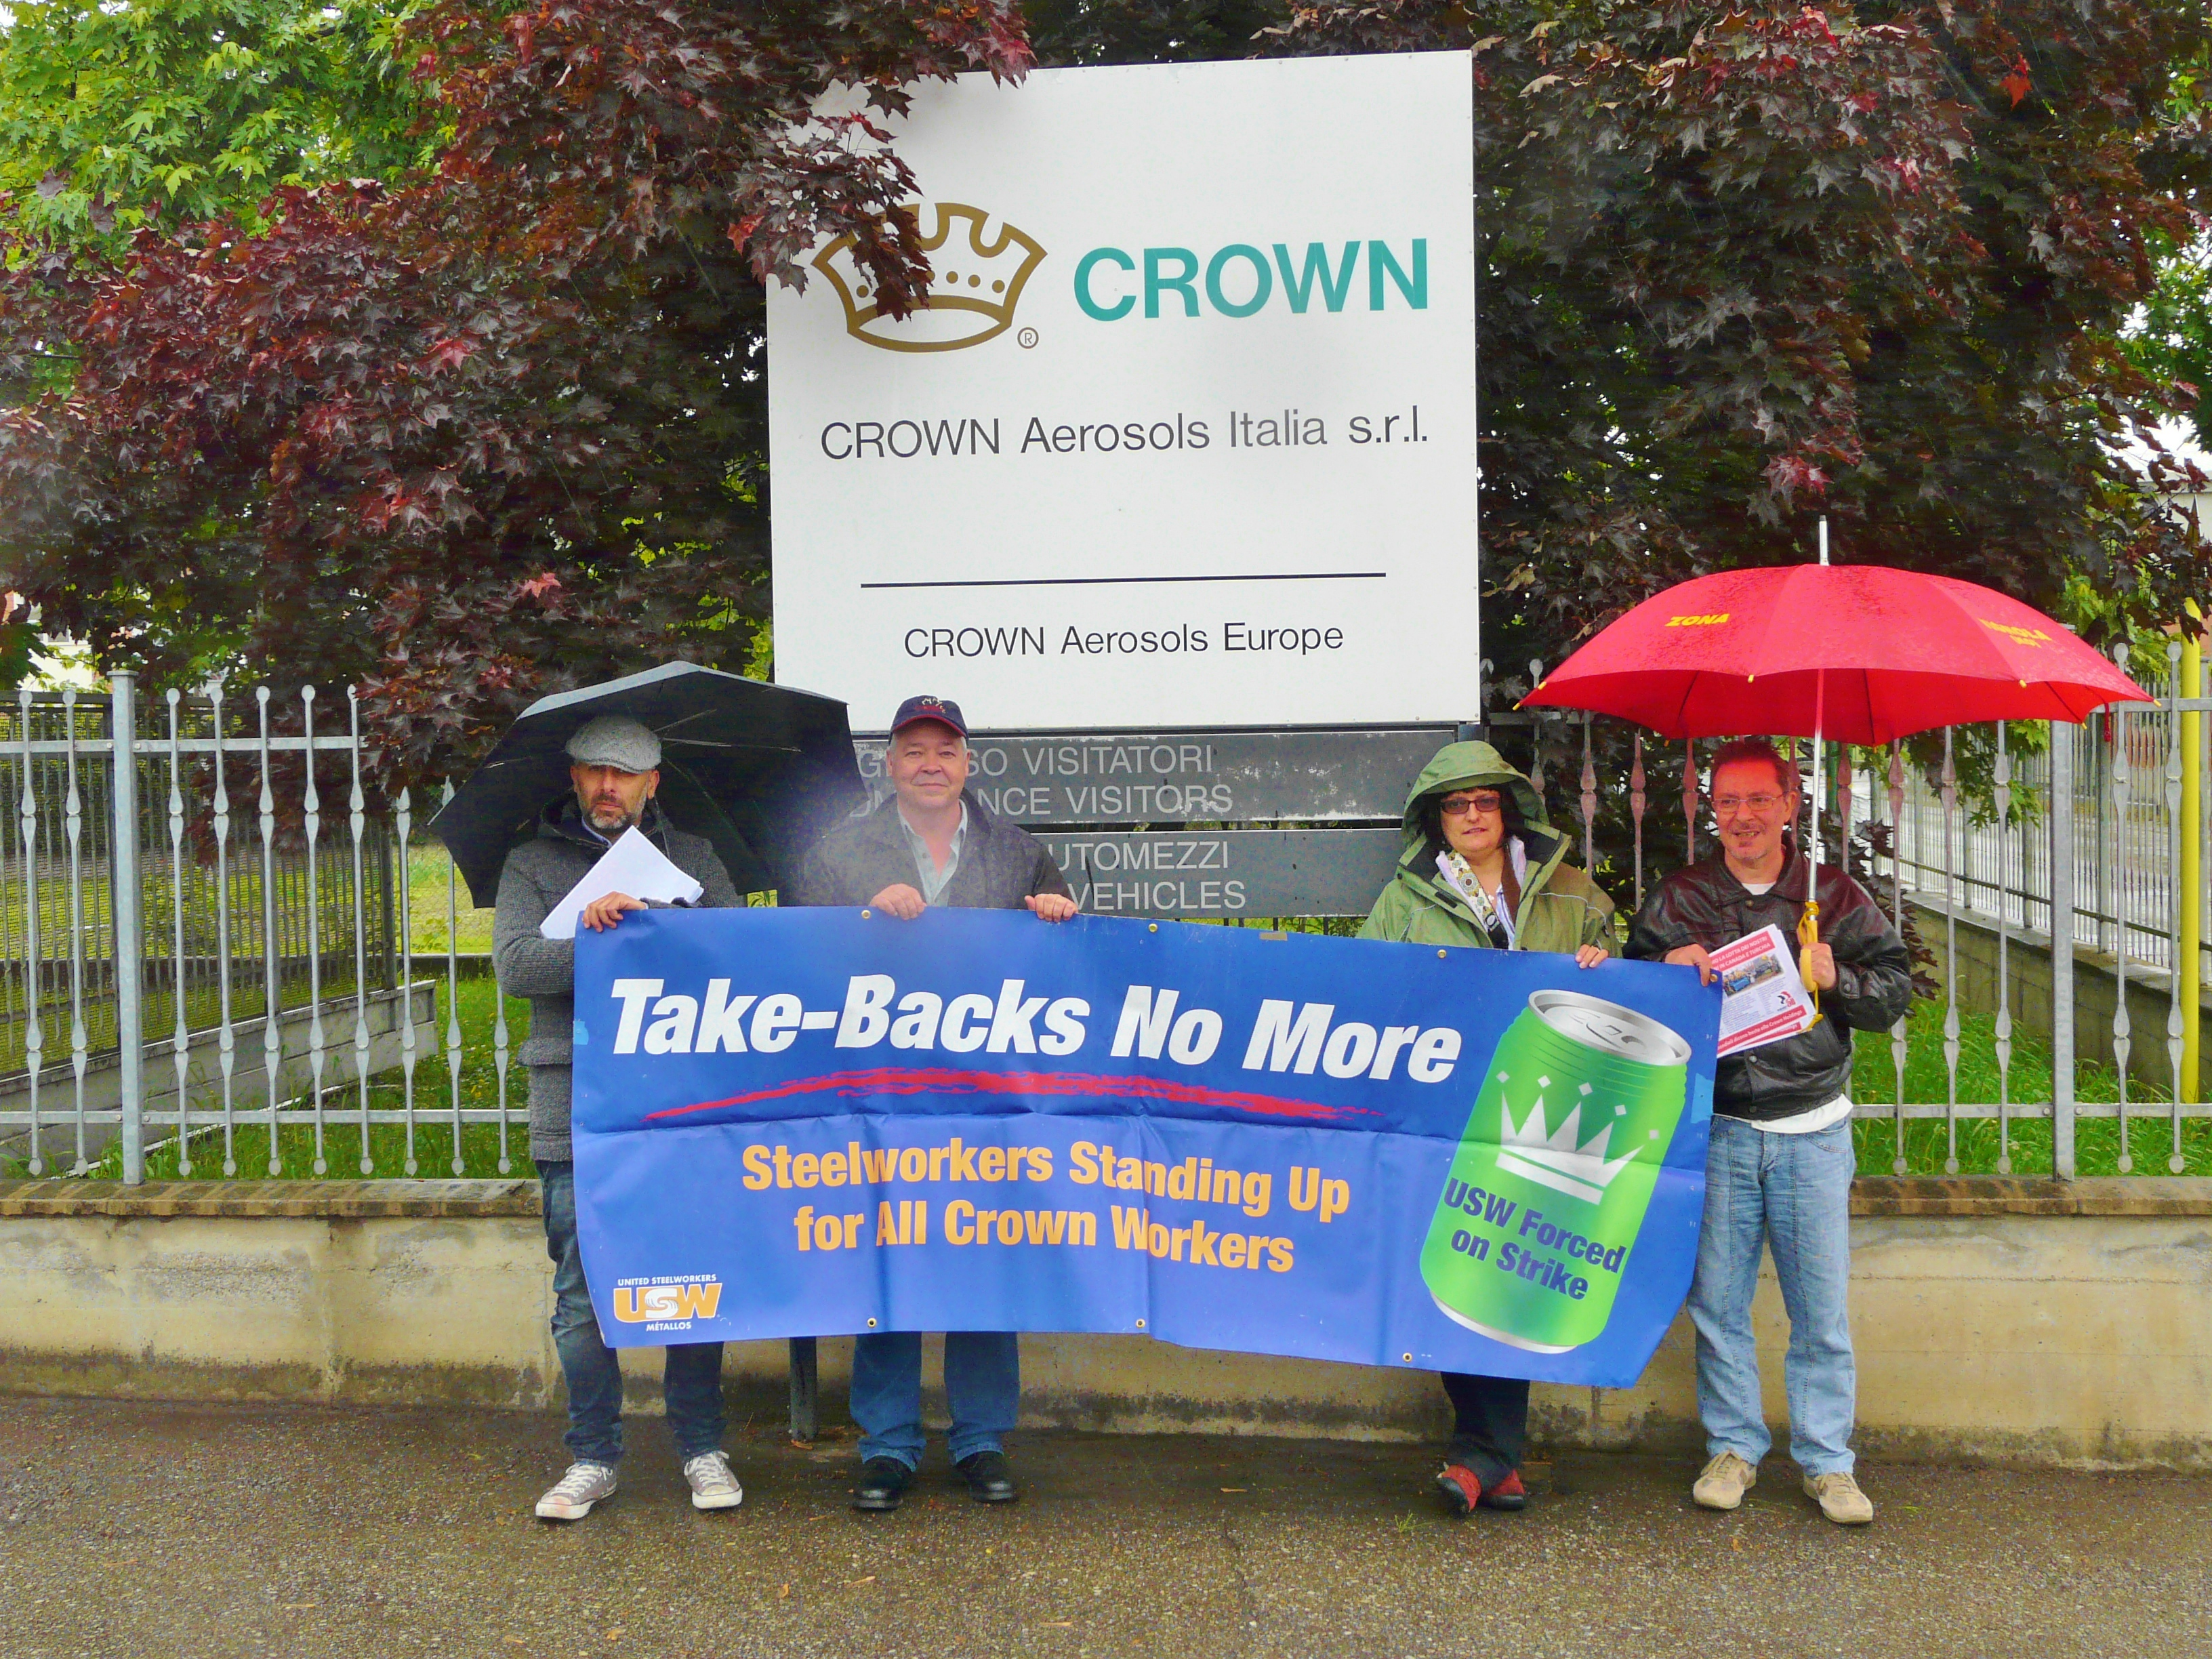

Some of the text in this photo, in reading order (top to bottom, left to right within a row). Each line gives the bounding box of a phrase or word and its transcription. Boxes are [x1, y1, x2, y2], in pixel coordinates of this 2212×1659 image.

[1074, 238, 1427, 321] CROWN
[821, 405, 1428, 459] CROWN Aerosols Italia s.r.l.
[1664, 613, 1730, 626] ZONA
[904, 621, 1344, 658] CROWN Aerosols Europe
[1023, 744, 1212, 775] VISITATORI
[1065, 784, 1233, 815] VISITORS
[1048, 840, 1229, 872] UTOMEZZI
[1067, 880, 1246, 912] VEHICLES
[1750, 937, 1767, 947] NOSTRI
[1725, 954, 1746, 966] CANADA
[611, 974, 1462, 1082] Take-Backs No More
[742, 1136, 1349, 1223] Steelworkers Standing Up
[795, 1200, 1294, 1273] for All Crown Workers
[1443, 1177, 1626, 1273] USW Forced
[617, 1274, 716, 1286] UNITED STEELWORKERS
[1451, 1229, 1589, 1300] on Strike
[613, 1283, 722, 1323] USW
[646, 1322, 691, 1332] MÉTALLOS
